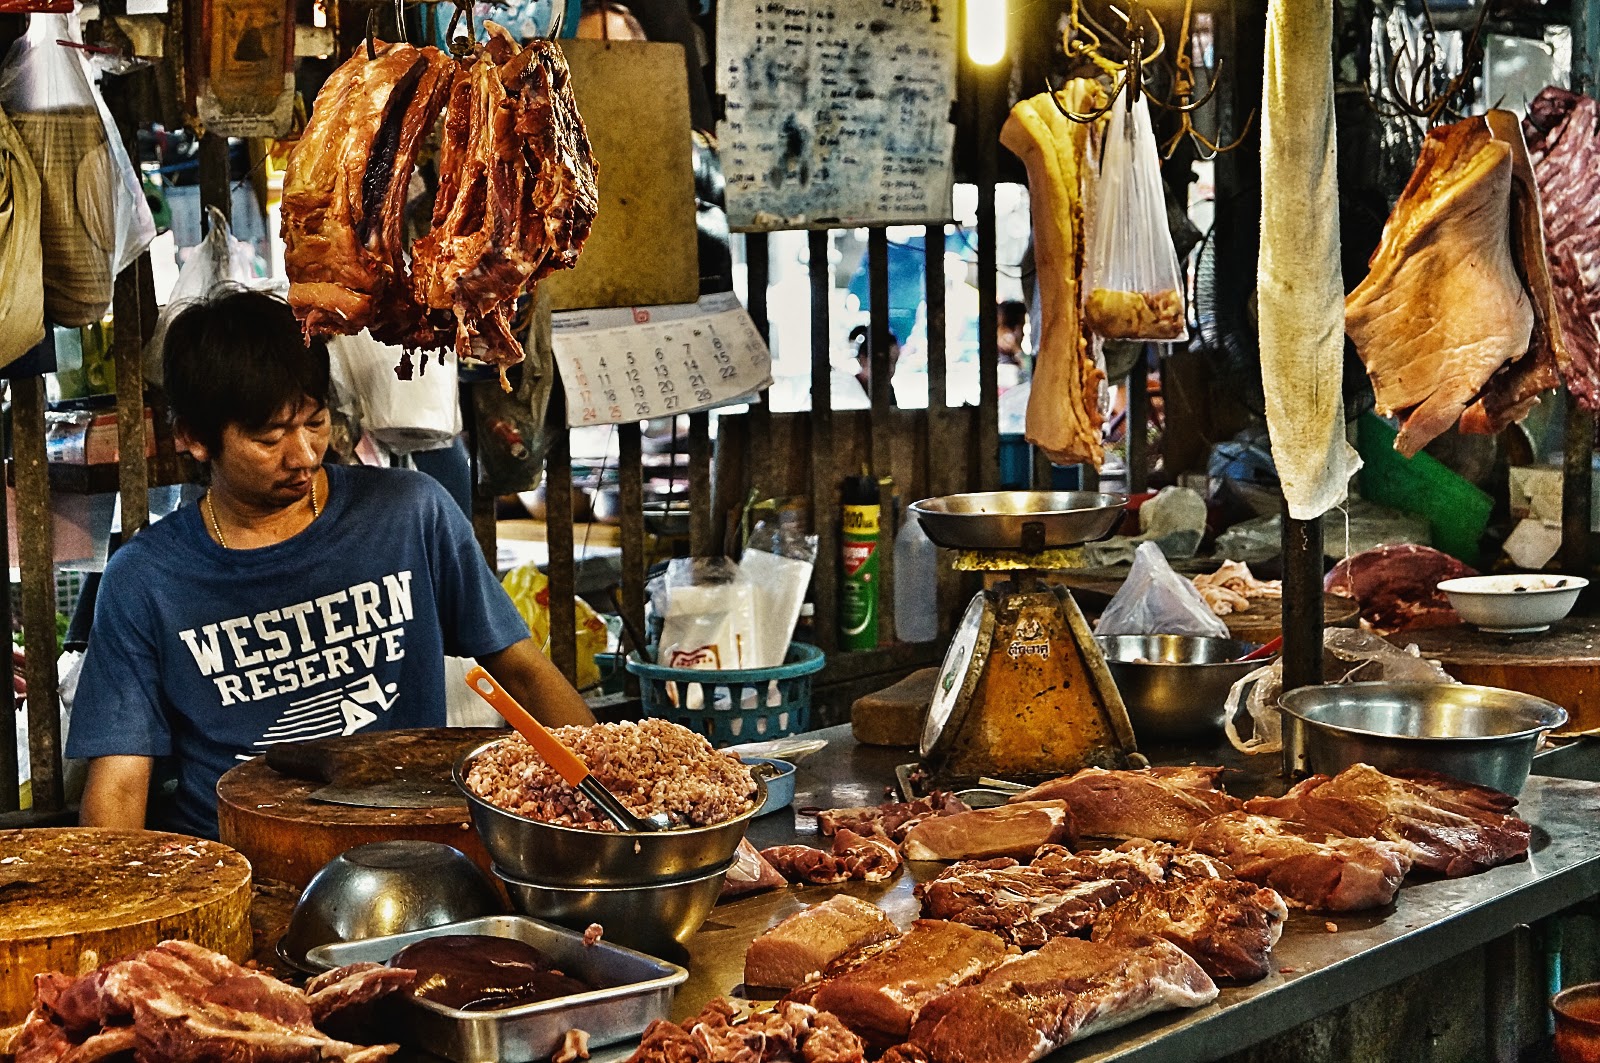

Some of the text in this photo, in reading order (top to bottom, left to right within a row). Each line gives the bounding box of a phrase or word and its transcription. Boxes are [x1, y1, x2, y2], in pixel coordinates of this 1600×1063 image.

[598, 373, 611, 386] 11
[626, 368, 640, 382] 12
[654, 364, 669, 378] 13
[683, 359, 699, 372] 14
[713, 351, 730, 364] 15
[599, 356, 607, 368] 4
[626, 351, 635, 365] 5
[655, 347, 664, 361] 6
[682, 343, 690, 356] 7
[712, 337, 722, 349] 8
[580, 389, 592, 402] 17
[604, 389, 617, 403] 18
[630, 384, 645, 398] 19
[658, 379, 675, 394] 20
[688, 373, 705, 388] 21
[718, 365, 738, 379] 22
[583, 388, 712, 421] 24 25 26 27 28
[179, 570, 414, 676] WESTERN
[213, 627, 405, 706] RESERVE
